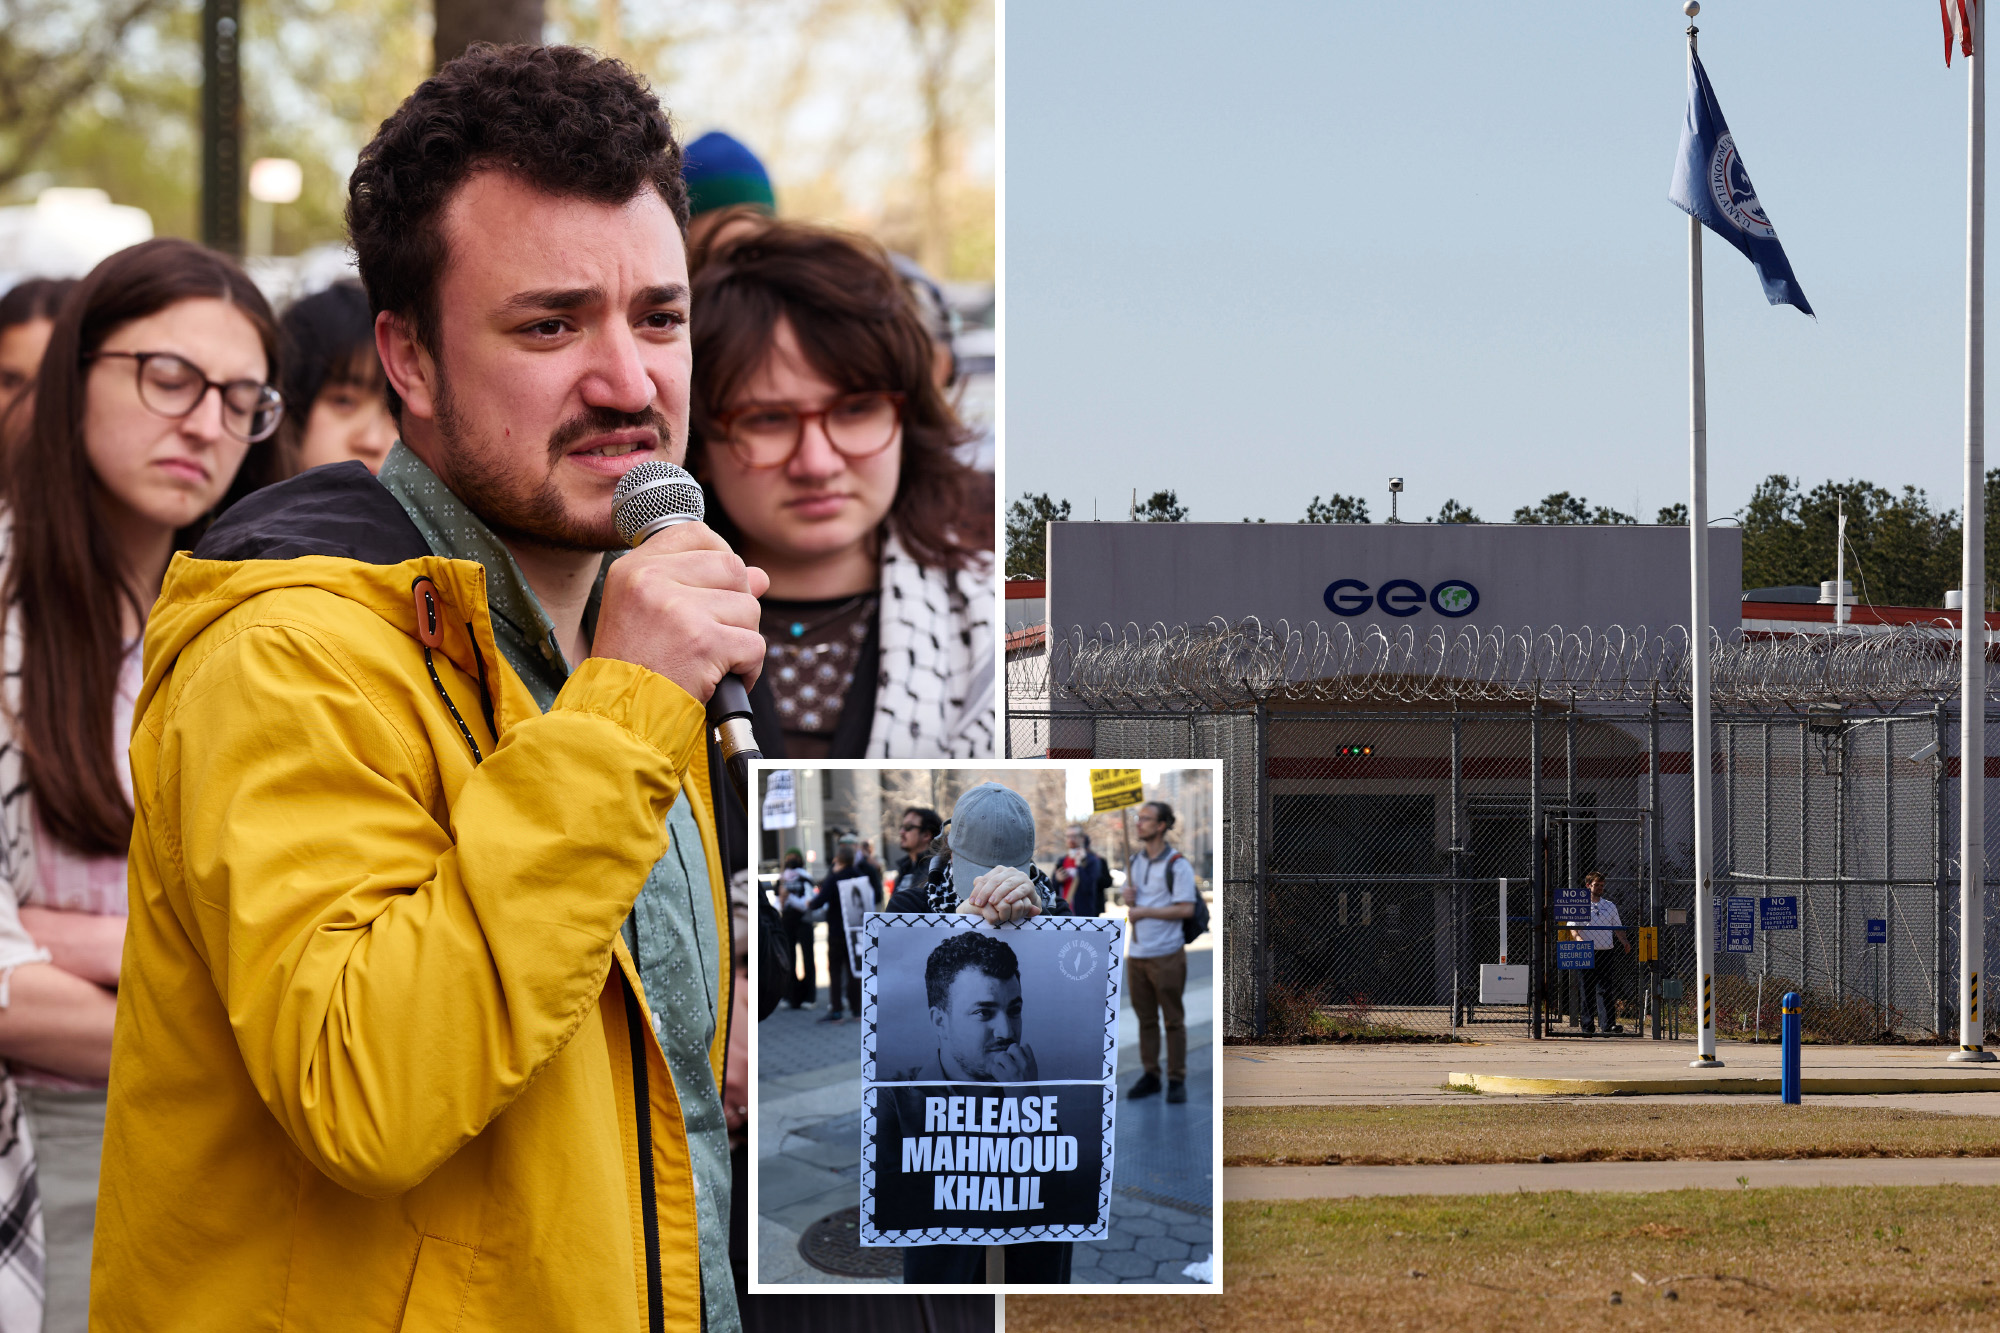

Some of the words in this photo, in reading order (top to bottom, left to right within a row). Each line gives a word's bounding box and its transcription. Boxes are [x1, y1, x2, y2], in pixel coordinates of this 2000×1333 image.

[1771, 898, 1785, 906] NO
[1072, 940, 1079, 948] IT
[1560, 943, 1576, 951] KEEP
[925, 1095, 1058, 1133] RELEASE
[901, 1136, 1079, 1173] MAHMOUD
[933, 1175, 1045, 1212] KHALIL
